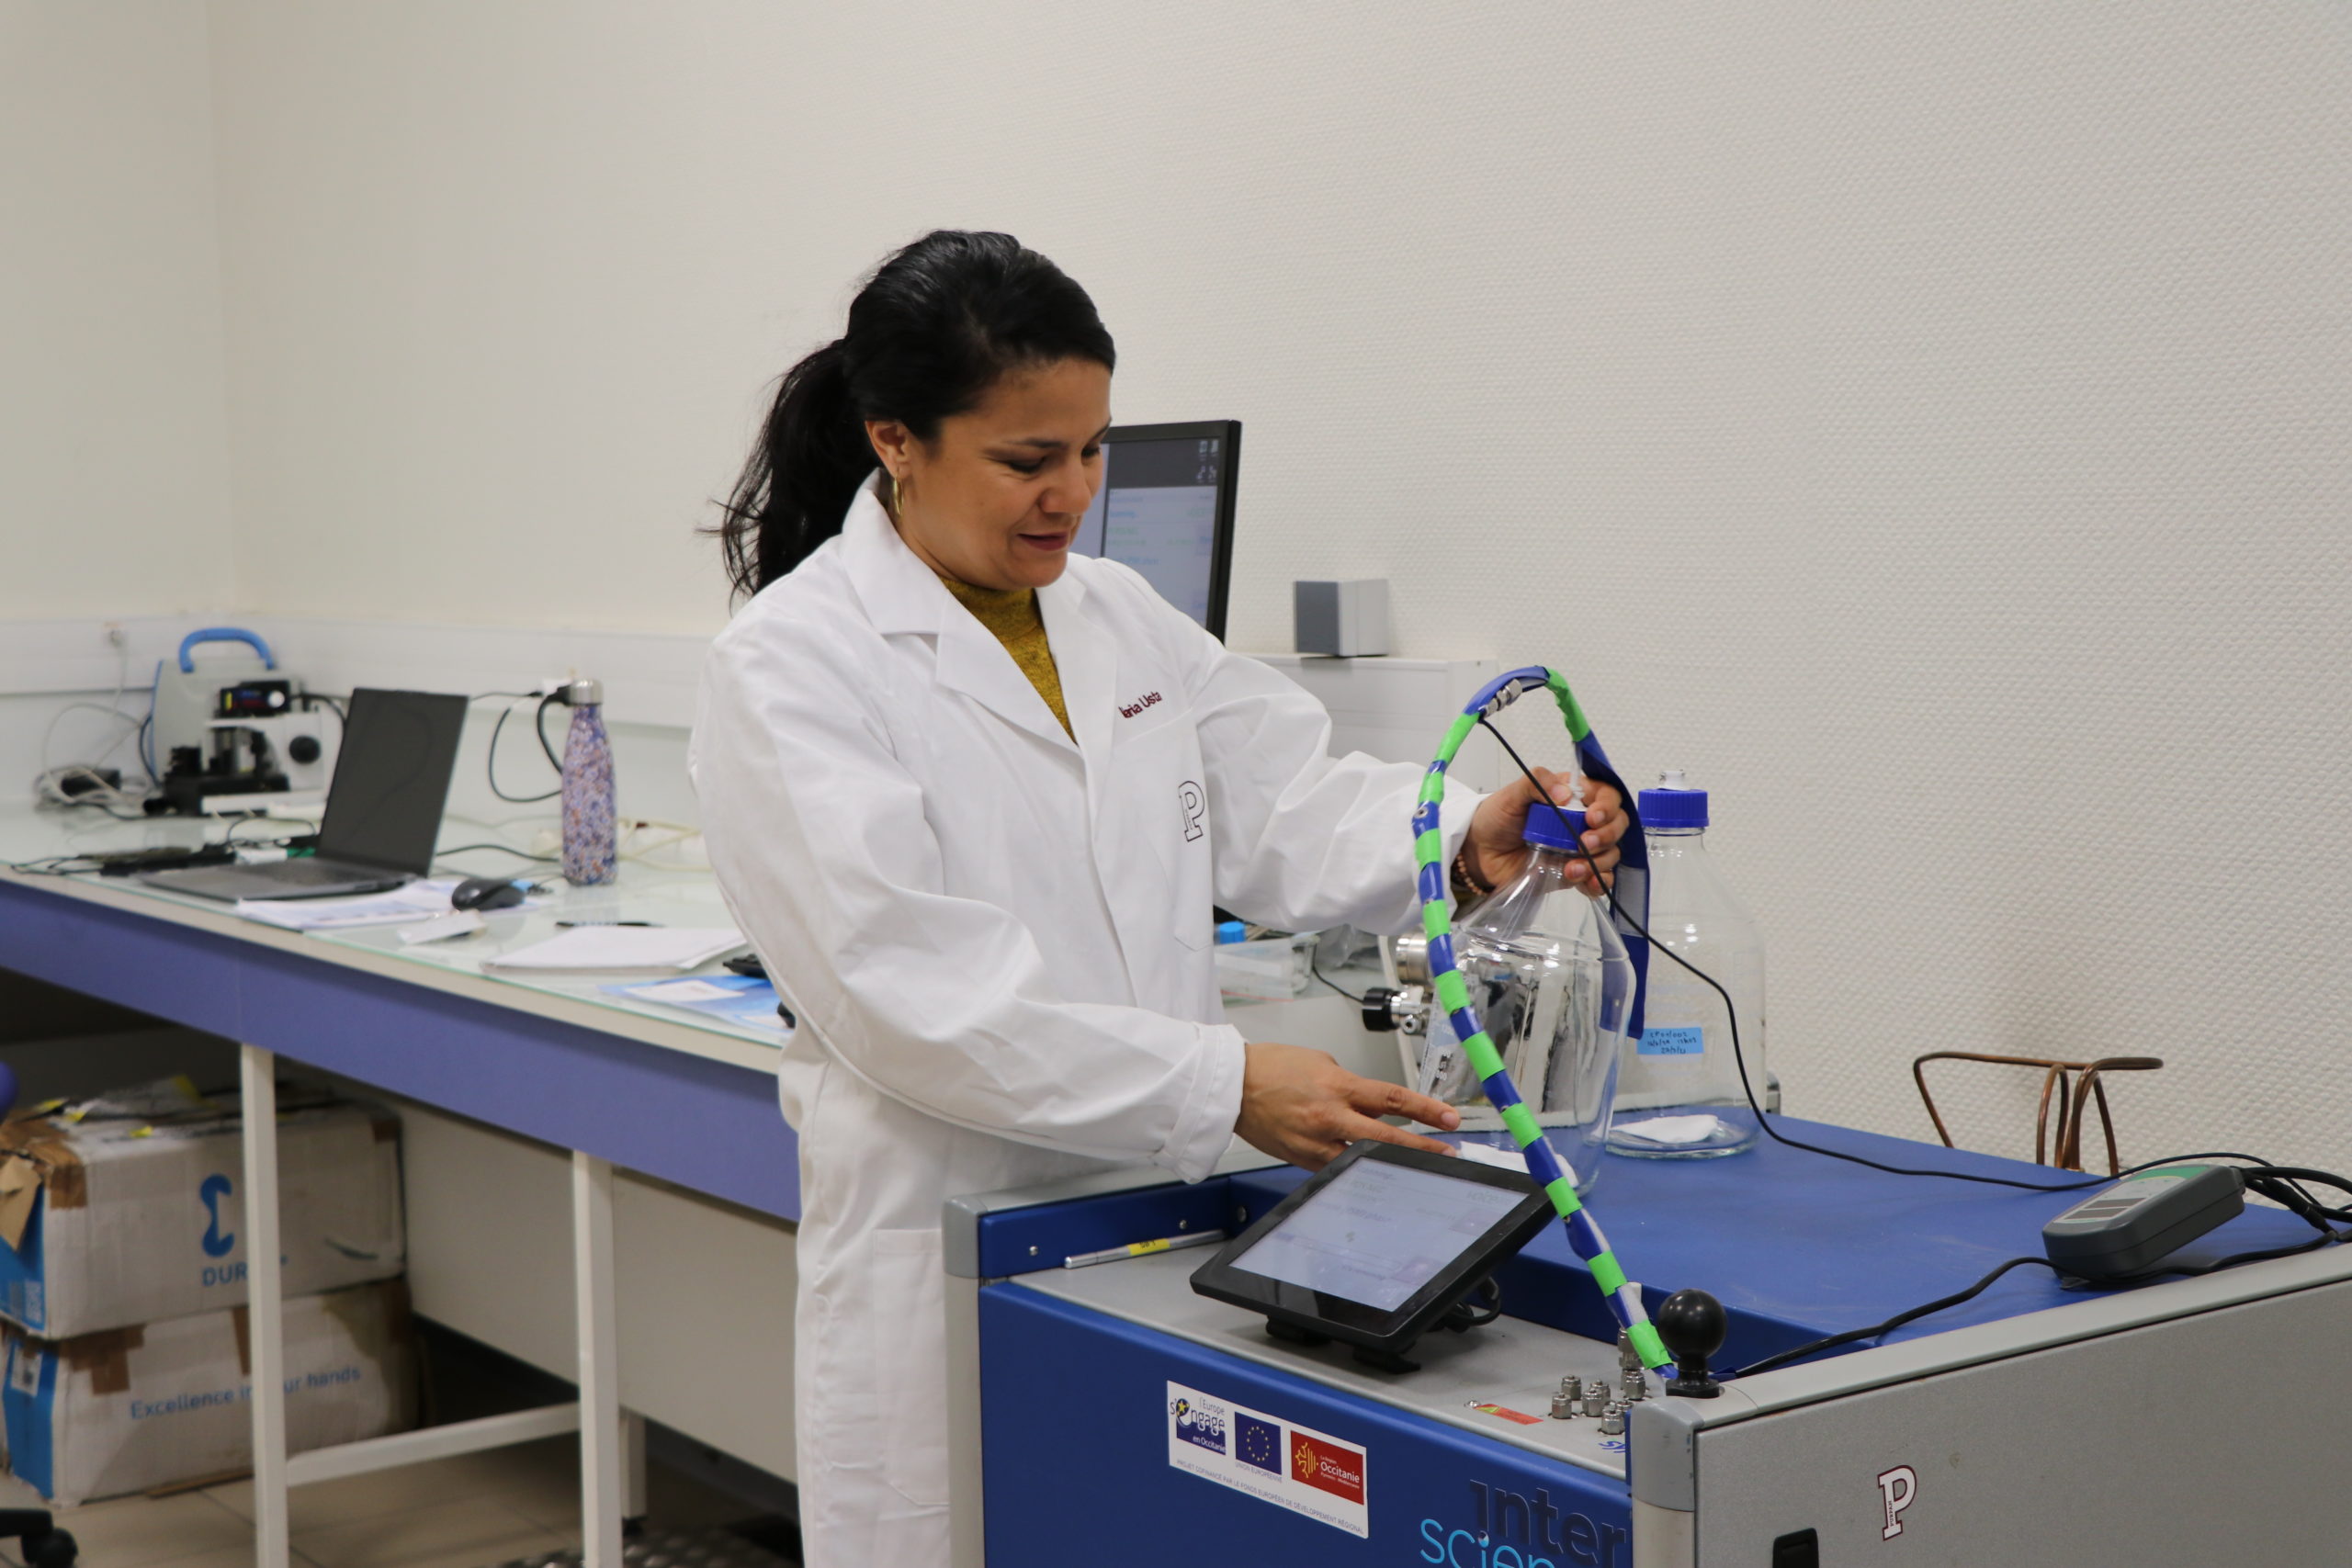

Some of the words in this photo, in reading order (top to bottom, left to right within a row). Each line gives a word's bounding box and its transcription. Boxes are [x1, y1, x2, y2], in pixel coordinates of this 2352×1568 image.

[203, 1260, 248, 1286] DUR
[131, 1388, 234, 1420] Excellence
[307, 1365, 361, 1388] hands
[1193, 1435, 1201, 1445] en
[1200, 1437, 1226, 1452] Occitanie
[1320, 1461, 1360, 1483] Occitanie
[1877, 1464, 1917, 1541] P
